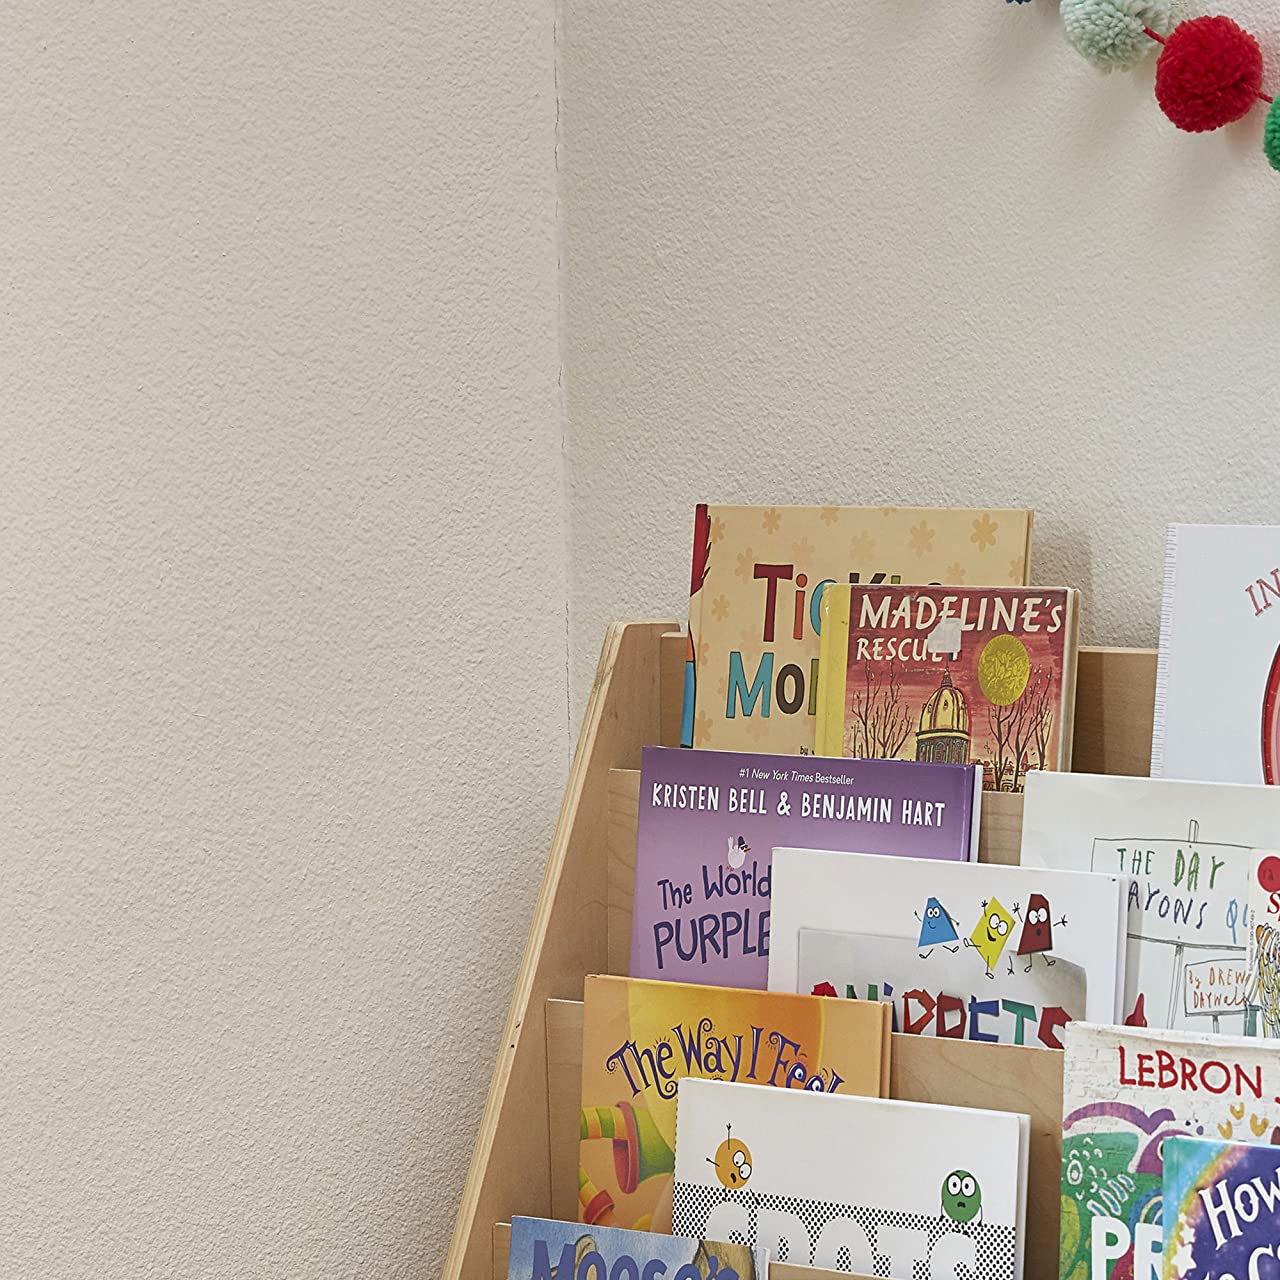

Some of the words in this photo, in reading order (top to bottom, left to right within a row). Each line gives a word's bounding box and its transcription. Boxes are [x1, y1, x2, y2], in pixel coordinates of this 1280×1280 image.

[859, 594, 1063, 634] MADELINE'S
[739, 768, 750, 778] #1
[751, 768, 770, 780] New
[772, 769, 788, 781] York
[791, 770, 814, 783] Times
[815, 772, 854, 785] Bestseller
[652, 782, 720, 811] KRISTEN
[728, 787, 767, 815] BELL
[776, 791, 791, 817] &
[801, 791, 892, 824] BENJAMIN
[901, 799, 946, 827] HART
[657, 878, 693, 911] The
[702, 861, 771, 900] World
[1117, 847, 1155, 875] THE
[1173, 849, 1225, 892] DAY
[653, 909, 771, 969] PURPLE
[1209, 967, 1246, 986] DREW
[606, 1038, 678, 1100] The
[672, 1017, 744, 1083] Way
[745, 1024, 764, 1079] I
